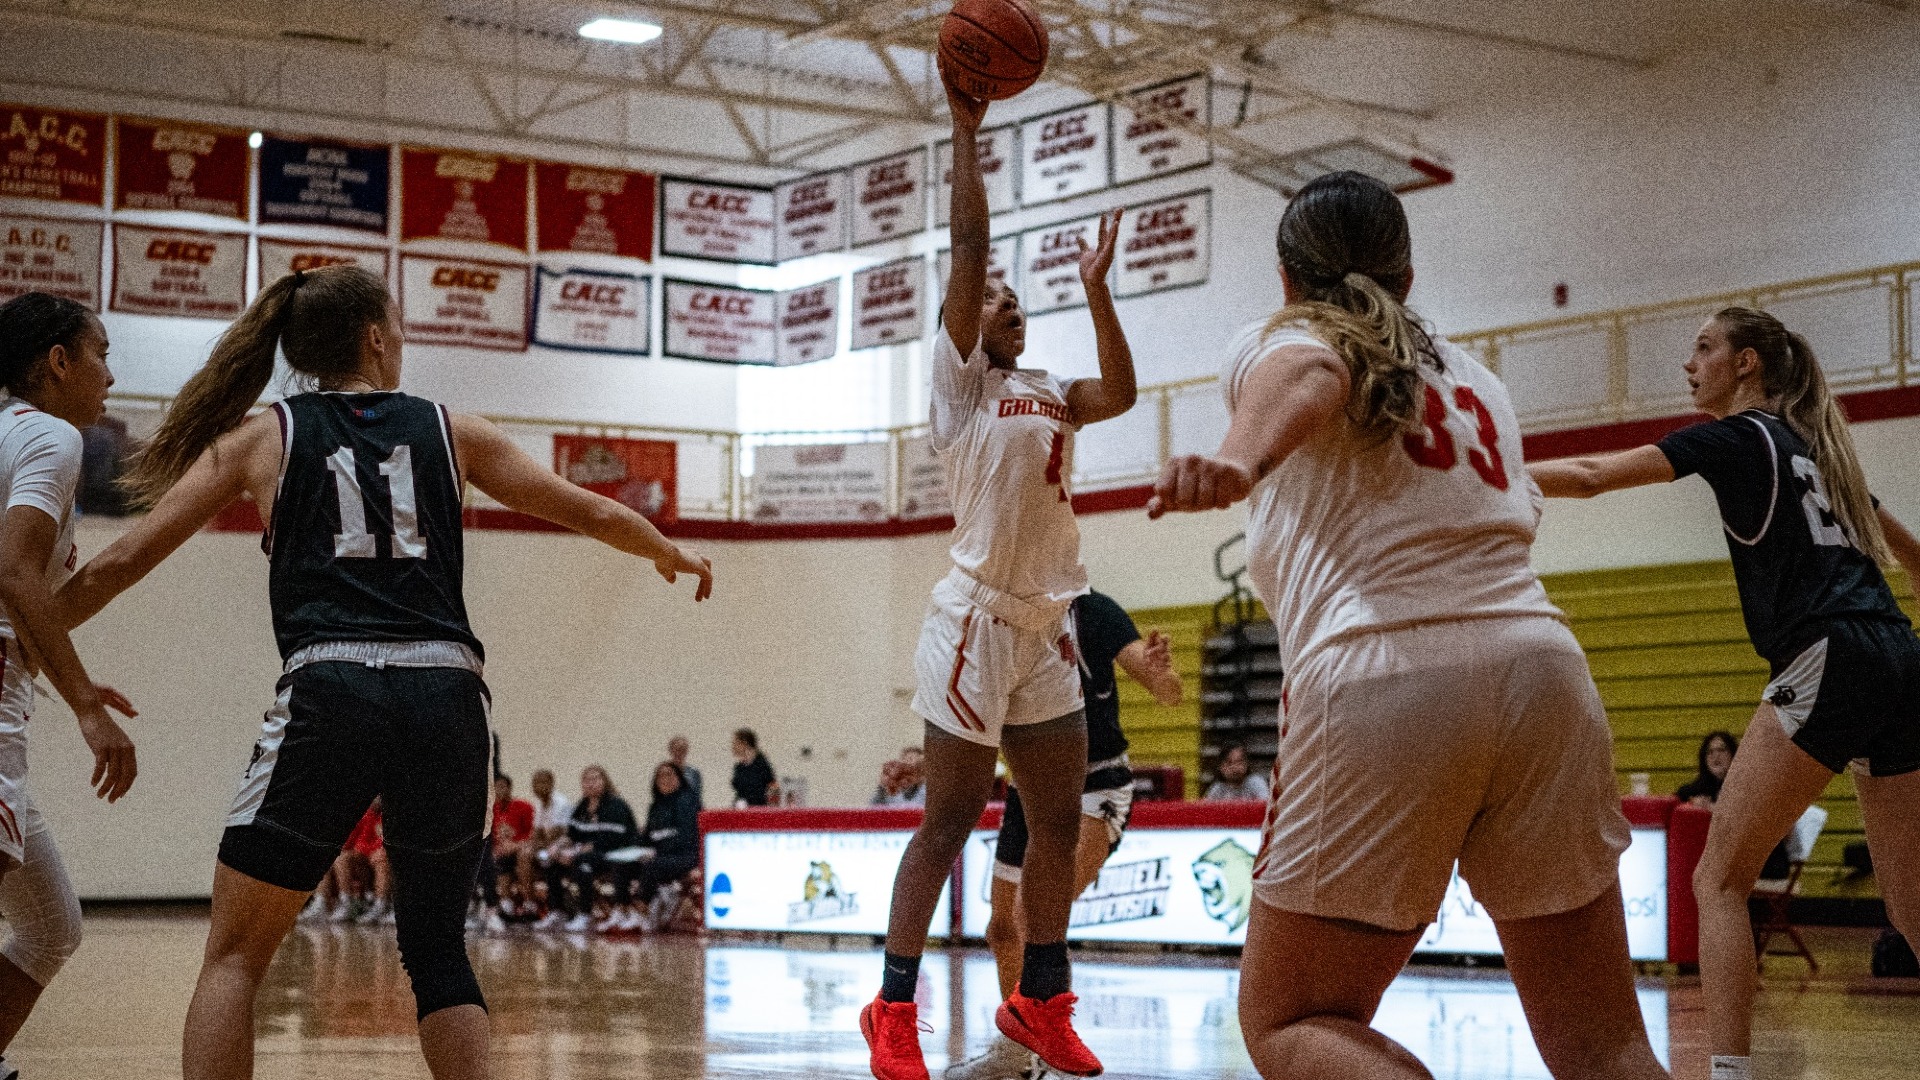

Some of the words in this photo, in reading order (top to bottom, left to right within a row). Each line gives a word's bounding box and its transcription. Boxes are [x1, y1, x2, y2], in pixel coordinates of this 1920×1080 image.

[688, 191, 750, 213] CACC
[146, 240, 216, 265] CACC
[432, 266, 499, 292] CACC
[561, 281, 626, 305] CACC
[690, 292, 752, 314] CACC
[1403, 382, 1509, 492] 33
[326, 444, 428, 560] 11
[1791, 453, 1866, 555] 2
[1070, 887, 1167, 928] NIVERSITY
